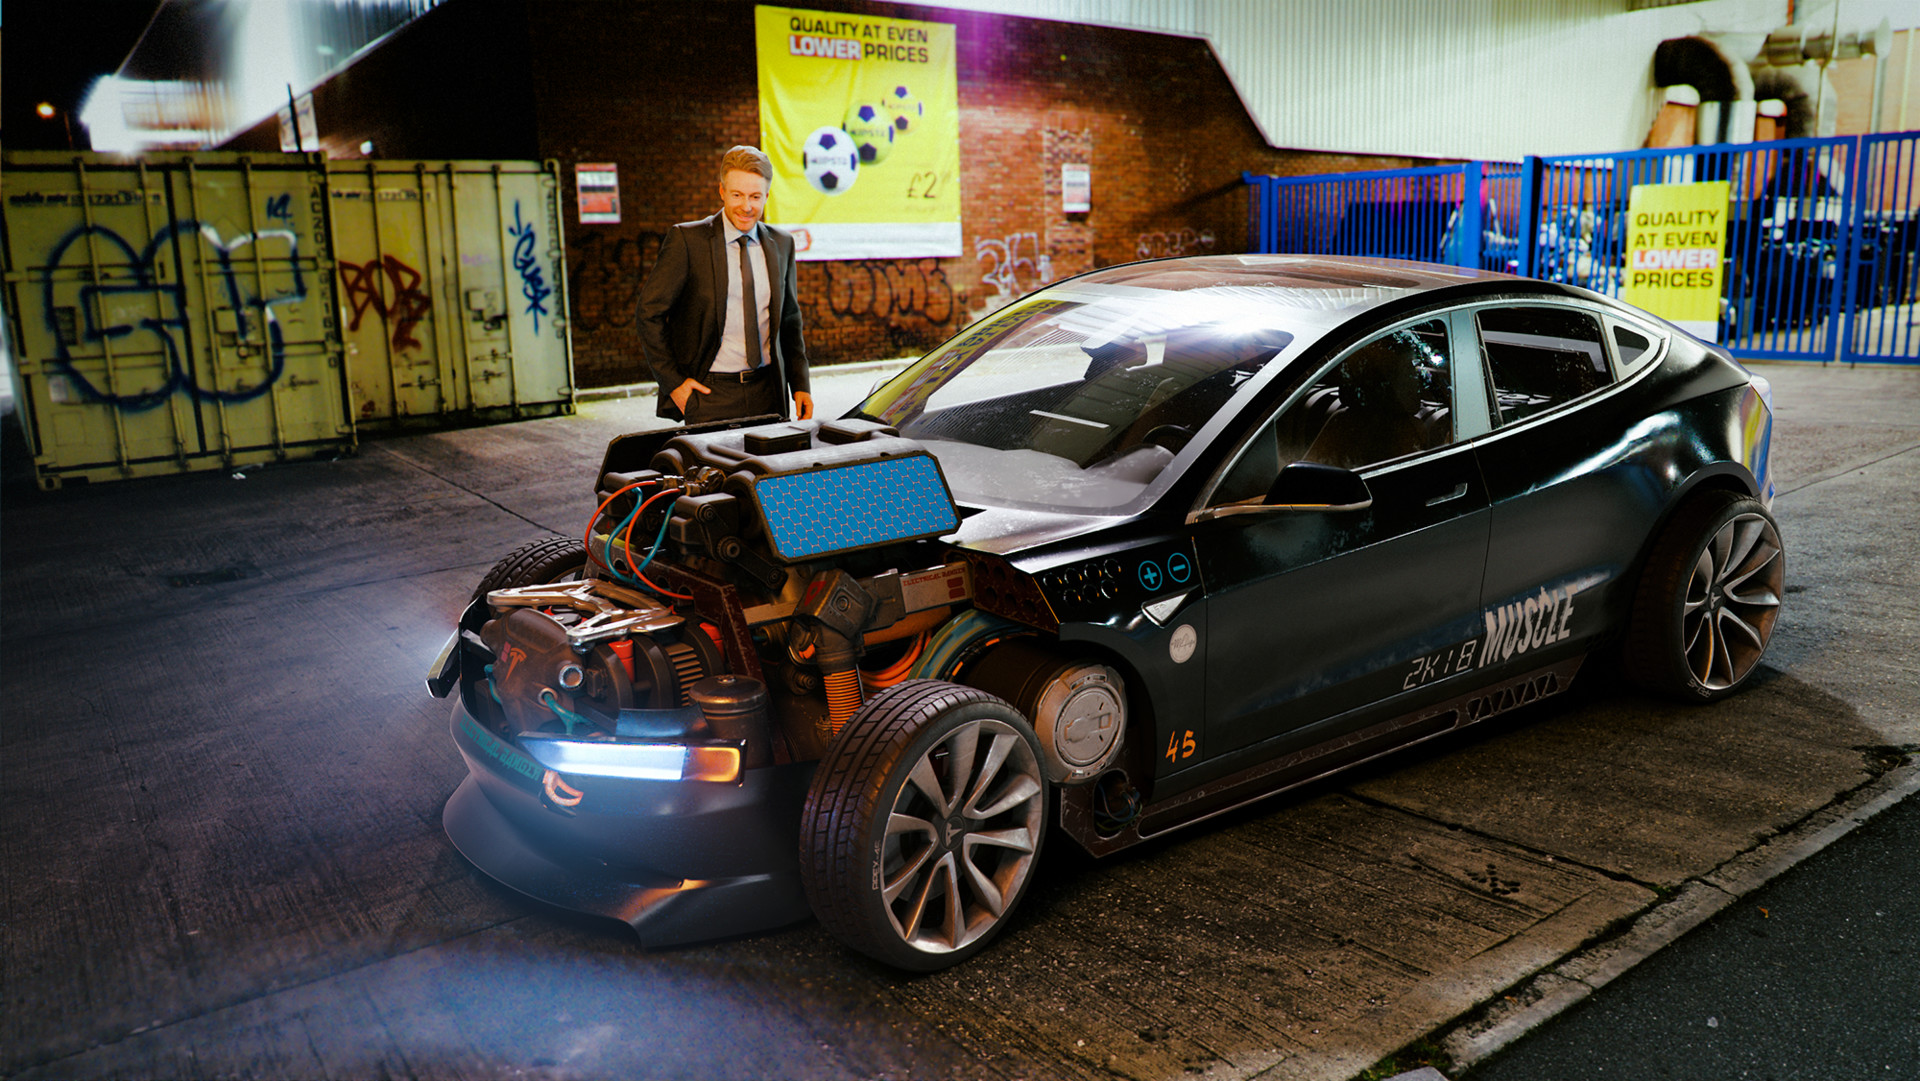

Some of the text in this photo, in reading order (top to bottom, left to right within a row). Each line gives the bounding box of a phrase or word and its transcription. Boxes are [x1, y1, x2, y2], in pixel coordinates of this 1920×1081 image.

[790, 17, 928, 43] QUALITY AT EVEN
[789, 35, 929, 63] LOWER PRICES
[1636, 210, 1720, 227] QUALITY
[1634, 231, 1718, 247] AT EVEN
[1632, 249, 1717, 269] LOWER
[1632, 271, 1714, 288] PRICES
[1402, 584, 1578, 690] 2K18 MUSCLE
[1165, 729, 1196, 763] 45
